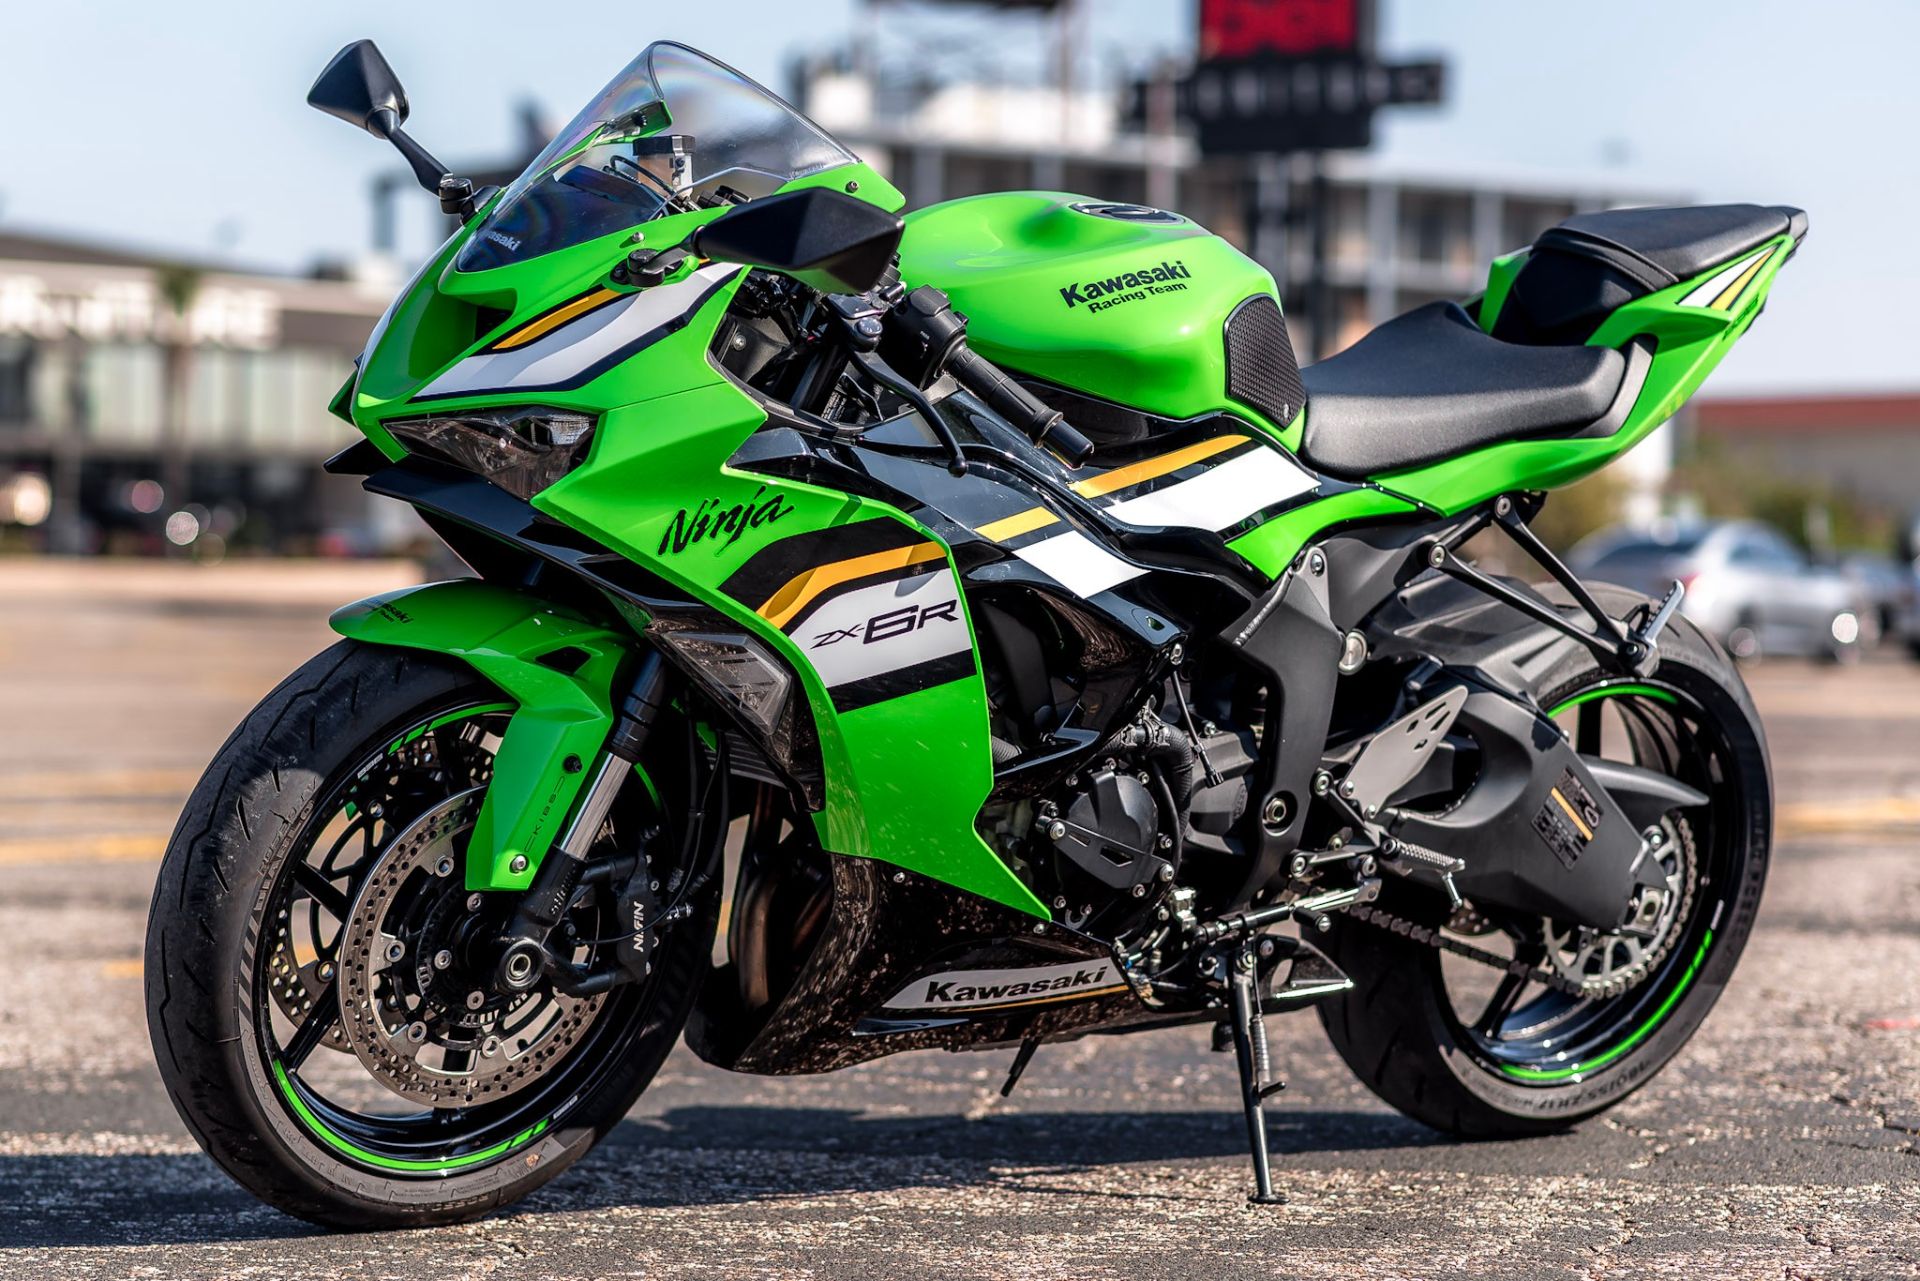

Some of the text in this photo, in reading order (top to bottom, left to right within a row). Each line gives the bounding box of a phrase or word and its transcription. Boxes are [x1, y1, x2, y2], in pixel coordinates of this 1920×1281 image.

[1059, 260, 1191, 308] Kawasaki
[1088, 282, 1188, 314] Racing Team
[657, 486, 794, 557] Ninja
[810, 599, 959, 650] ZX-6R
[253, 799, 315, 911] DIABLO
[924, 966, 1108, 1003] Kawasaki
